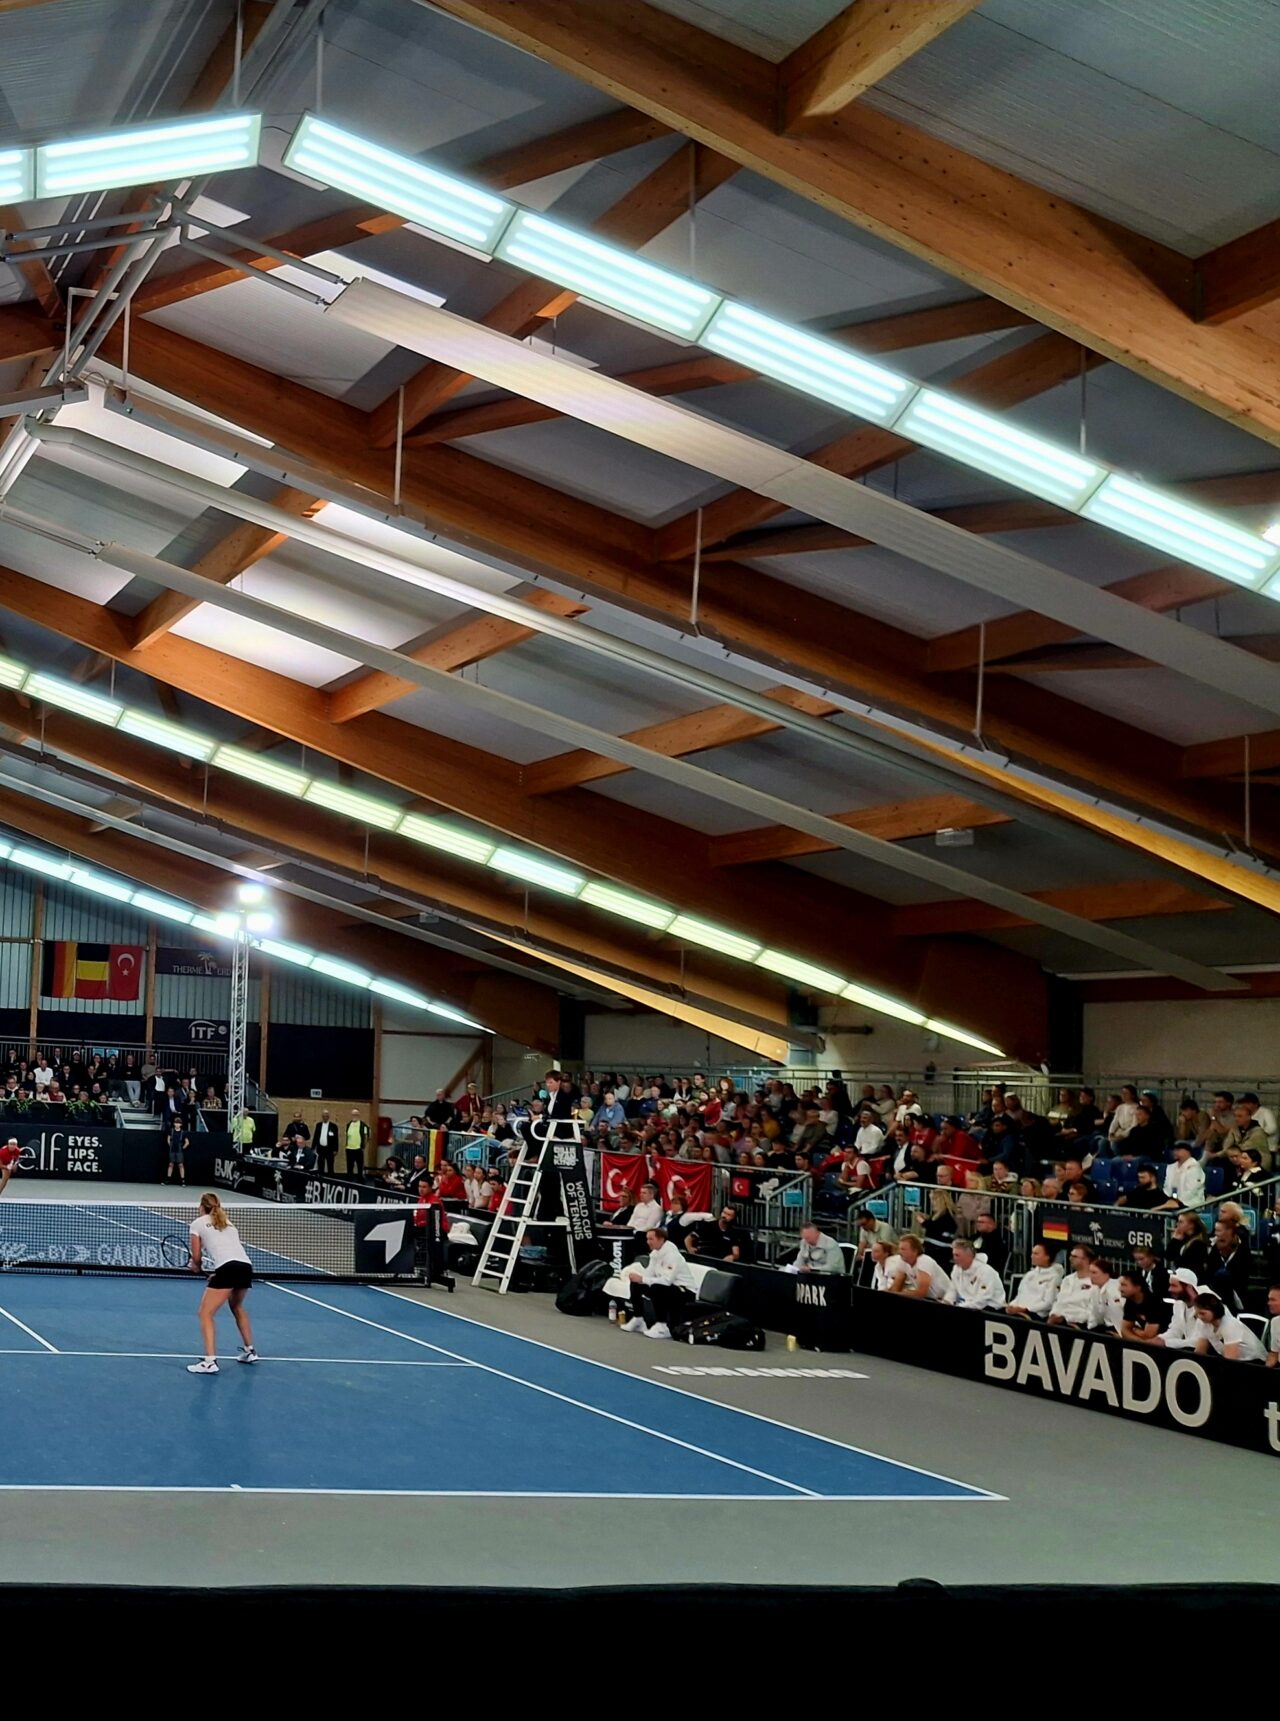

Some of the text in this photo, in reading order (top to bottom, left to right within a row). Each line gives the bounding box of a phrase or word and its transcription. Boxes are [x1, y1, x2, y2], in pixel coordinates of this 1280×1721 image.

[191, 1026, 216, 1039] ITF
[68, 1136, 103, 1148] EYES.
[68, 1148, 99, 1160] LIPS.
[67, 1161, 103, 1172] FACE.
[566, 1182, 585, 1240] OF TENNIS
[575, 1180, 593, 1240] WORLD CUP
[1128, 1230, 1153, 1248] GER
[48, 1245, 67, 1260] BY
[984, 1320, 1212, 1428] BAVADO
